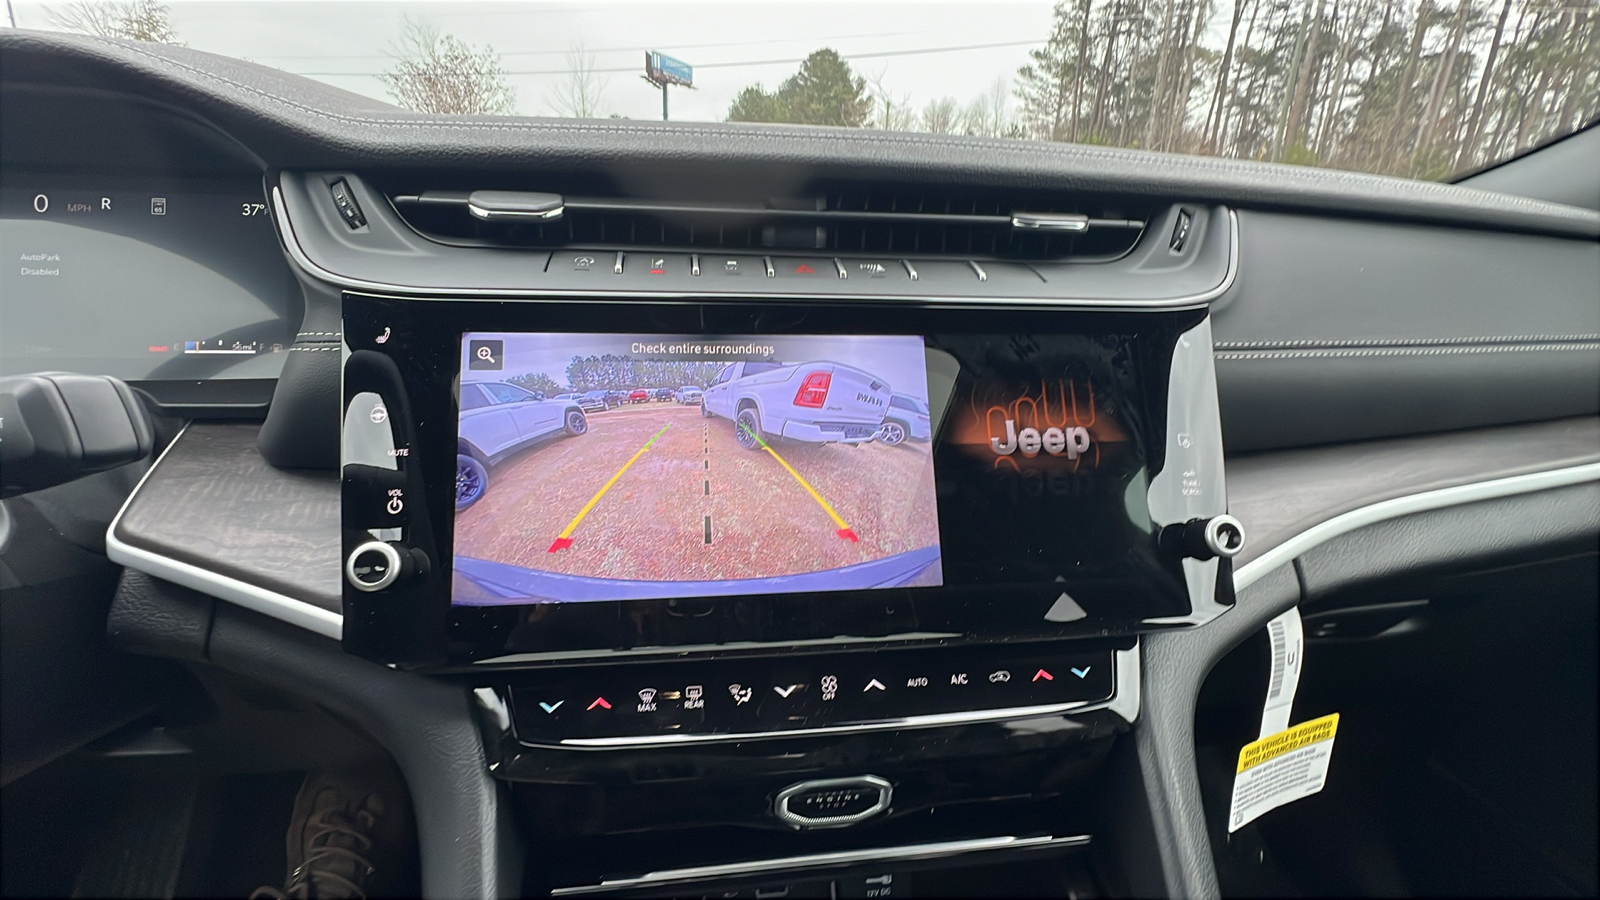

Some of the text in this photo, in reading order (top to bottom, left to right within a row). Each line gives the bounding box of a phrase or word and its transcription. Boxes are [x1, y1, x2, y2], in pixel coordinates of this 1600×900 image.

[33, 194, 92, 213] 0 MPH
[101, 197, 111, 210] R
[20, 253, 61, 262] AutoPark
[20, 267, 60, 276] Disabled
[631, 342, 775, 357] Check entire surroundings
[990, 419, 1090, 460] Jeep
[387, 448, 409, 457] MUTE
[387, 488, 403, 497] VOL
[907, 677, 928, 688] AUTO
[950, 673, 969, 686] A/C
[822, 692, 836, 701] OFF
[637, 702, 657, 713] MAX
[684, 700, 704, 710] REAR
[1245, 720, 1333, 760] THIS VEHICLE IS EQUIPPED
[1243, 730, 1331, 769] WITH ADVANCED AIR BAGS
